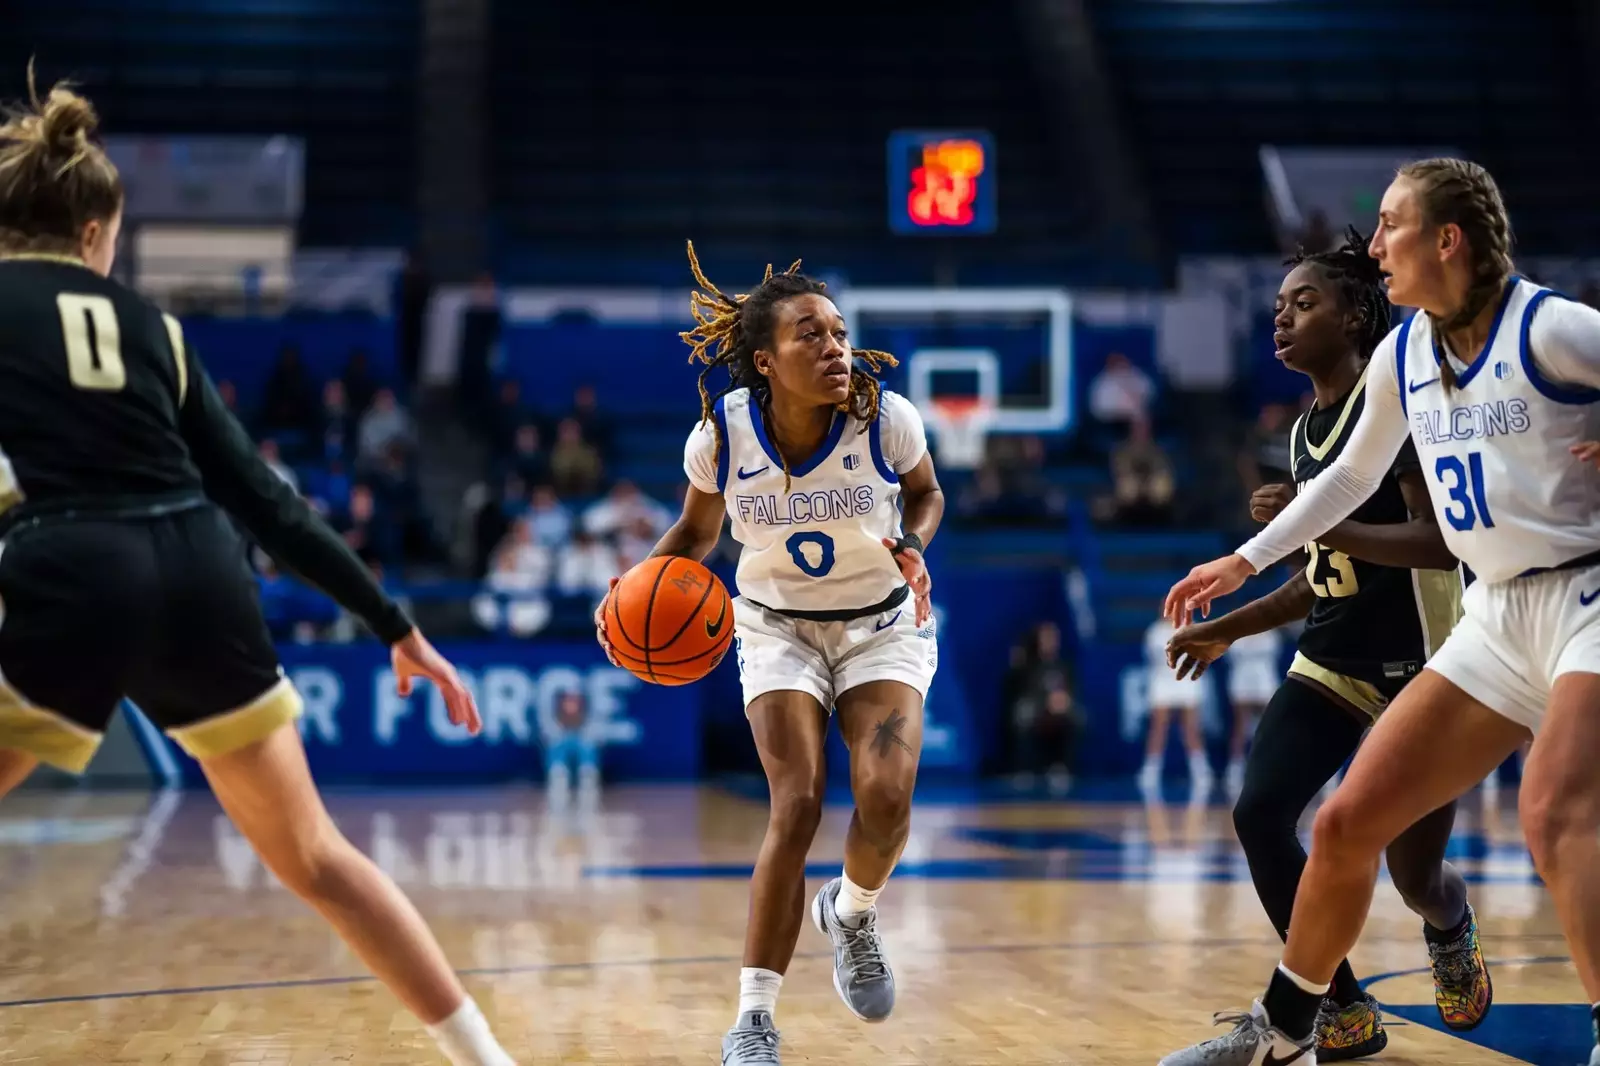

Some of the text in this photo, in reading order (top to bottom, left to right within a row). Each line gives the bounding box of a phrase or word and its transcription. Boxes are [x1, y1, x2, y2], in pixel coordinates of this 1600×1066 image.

[56, 292, 126, 391] 0
[1414, 398, 1531, 446] FALCONS
[736, 485, 874, 525] FALCONS
[1435, 451, 1496, 532] 31
[785, 531, 835, 578] 0
[1304, 540, 1360, 598] 23
[373, 667, 642, 746] FORCE
